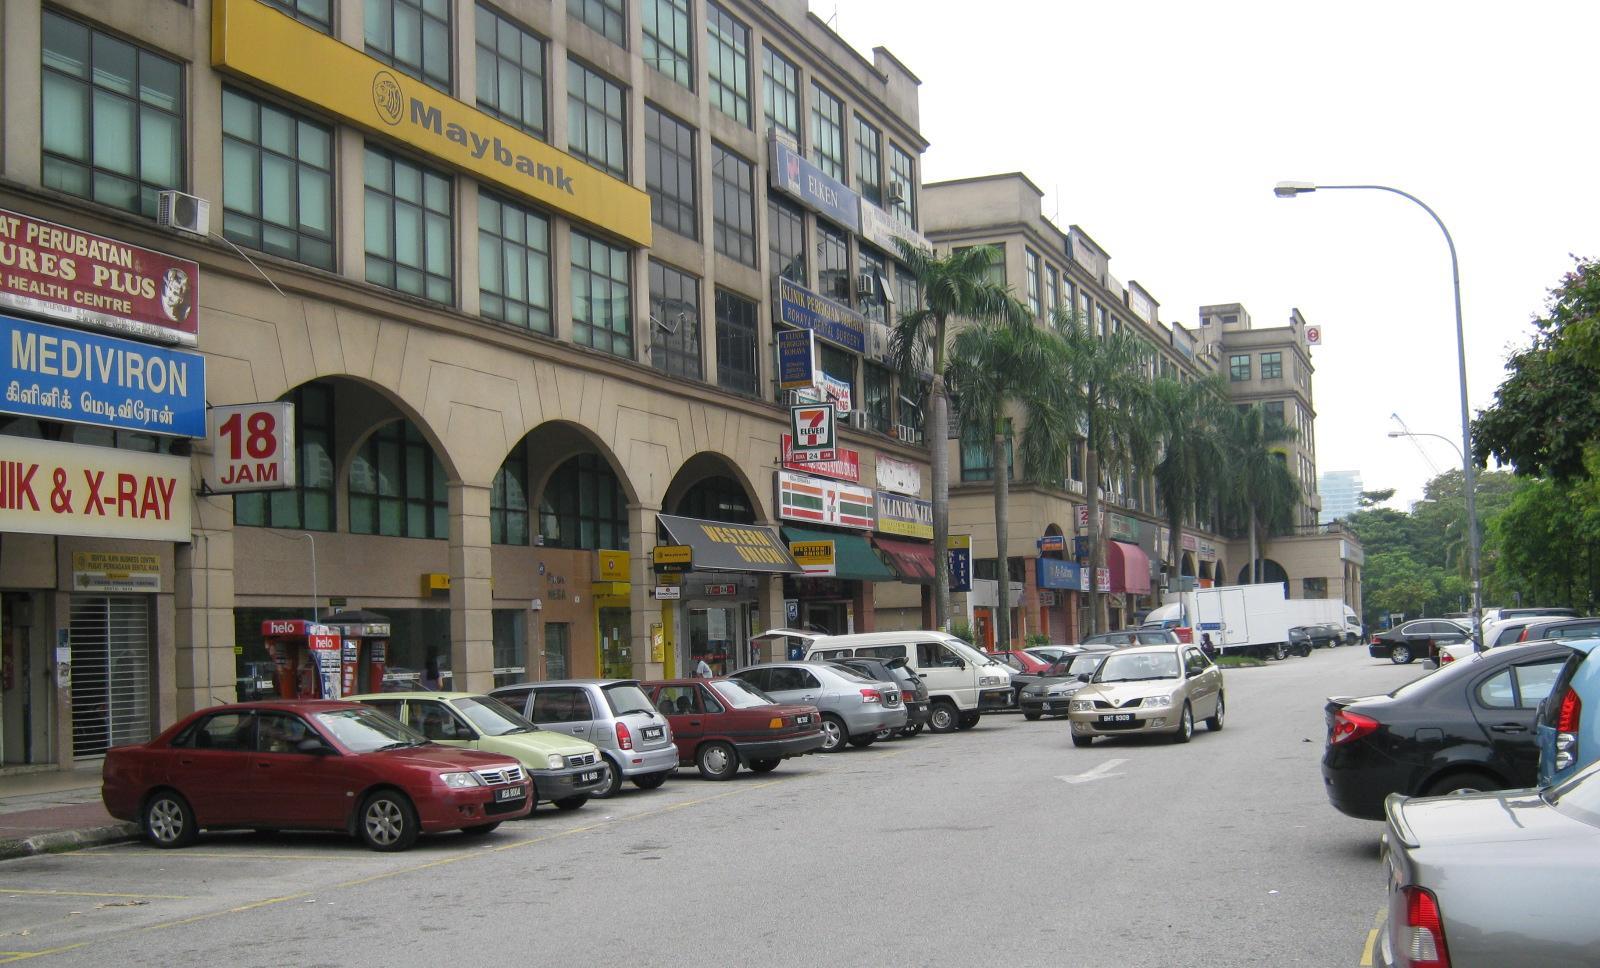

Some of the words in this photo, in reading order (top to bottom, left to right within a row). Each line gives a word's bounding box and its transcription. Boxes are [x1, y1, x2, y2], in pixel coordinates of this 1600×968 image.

[410, 97, 575, 196] Maybank
[808, 174, 838, 209] ELKEN
[27, 222, 132, 269] PERUBATAN
[0, 241, 77, 281] URES
[93, 265, 156, 299] PLUS
[8, 274, 68, 300] HEALTH
[73, 290, 132, 314] CENTRE
[782, 284, 805, 309] KLINIK
[11, 329, 188, 397] MEDIVIRON
[219, 412, 278, 460] 18
[221, 462, 278, 485] JAM
[51, 468, 73, 513] &
[84, 469, 177, 521] X-RAY
[880, 497, 912, 518] KLINIK
[700, 524, 772, 547] WESTERN
[735, 545, 787, 565] UNION
[271, 622, 295, 633] helo
[315, 637, 333, 648] helo
